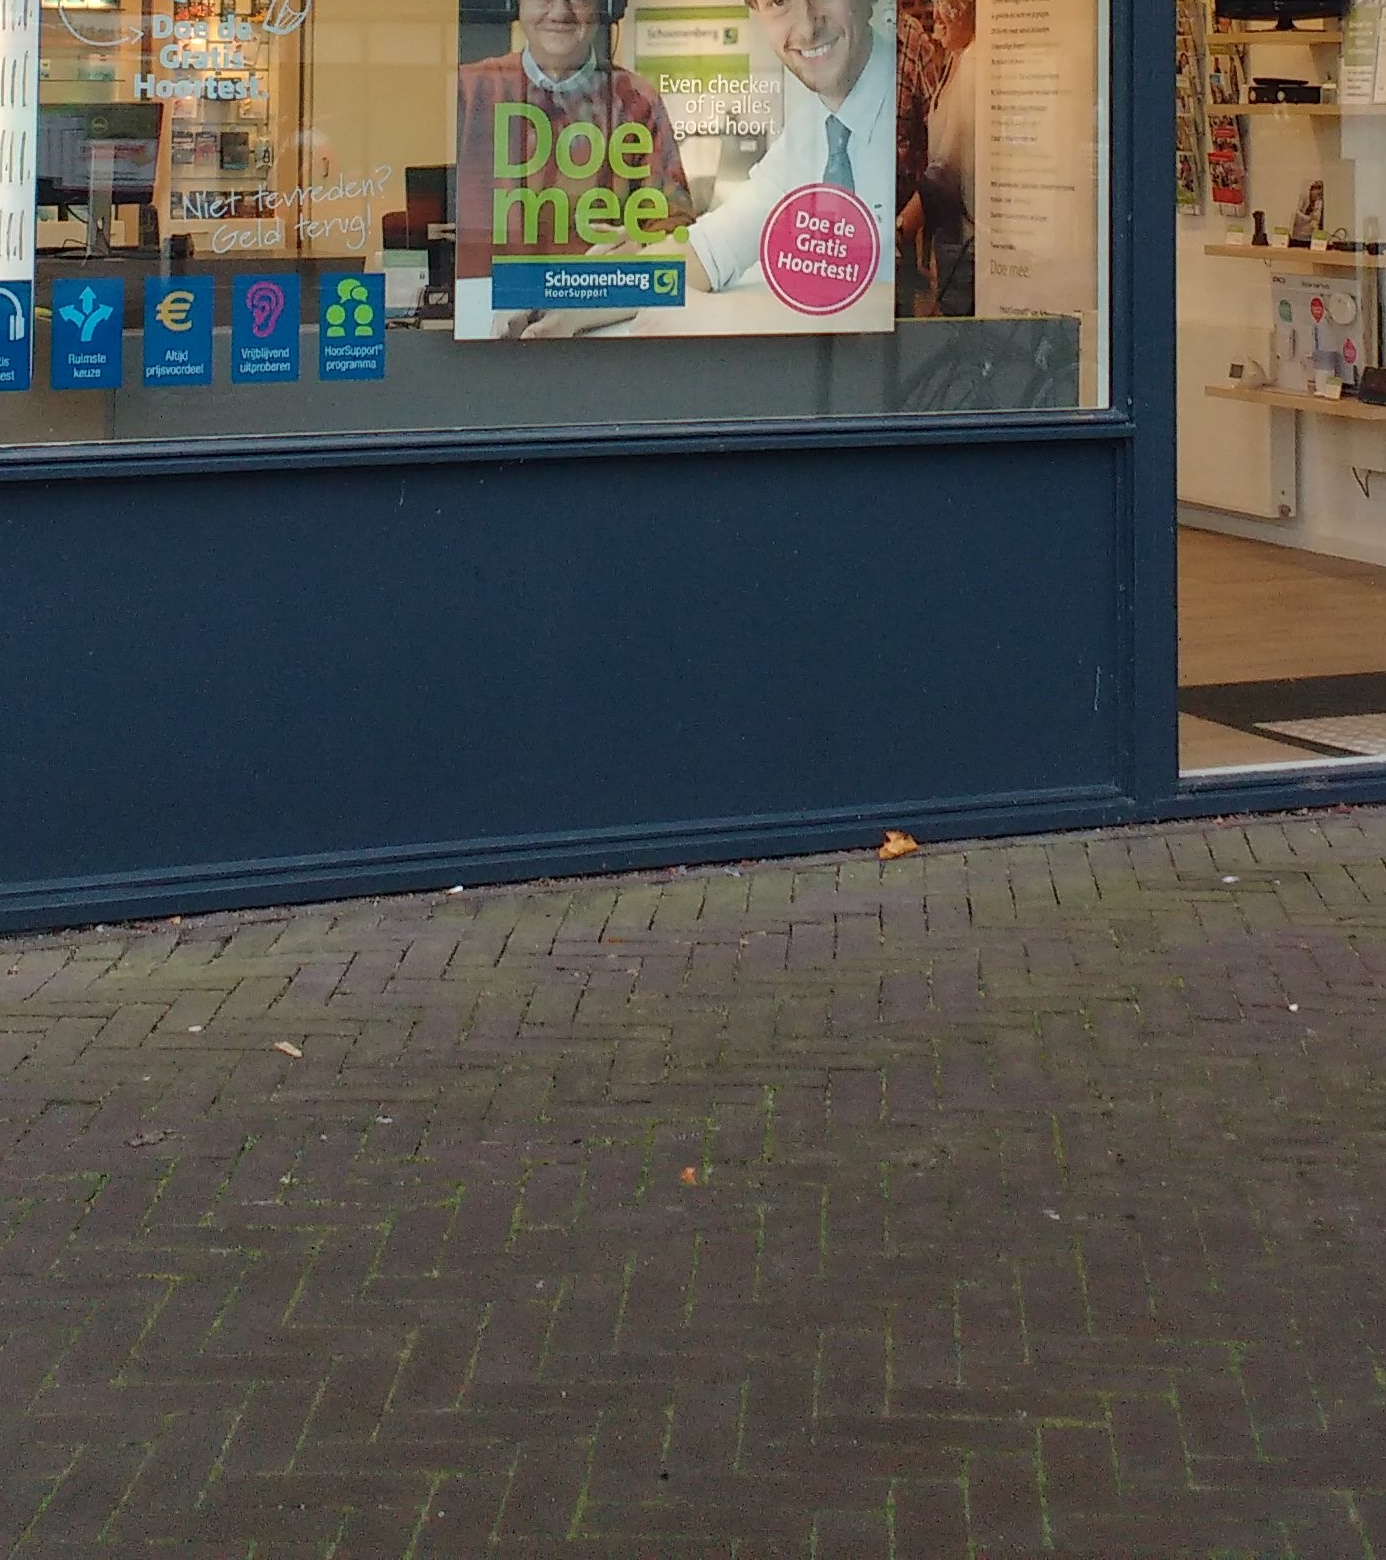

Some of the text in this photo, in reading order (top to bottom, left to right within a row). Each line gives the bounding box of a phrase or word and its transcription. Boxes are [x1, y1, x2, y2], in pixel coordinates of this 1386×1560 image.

[153, 14, 252, 41] Doe de
[159, 43, 244, 69] Gratis
[660, 74, 781, 94] Even checken
[685, 95, 771, 119] of je alles
[673, 115, 781, 140] goed hoort.
[493, 102, 654, 179] Doe
[182, 166, 392, 222] Niet tevreden?
[492, 187, 690, 244] mee.
[795, 210, 856, 238] Doe de
[212, 203, 372, 254] Geld terug!
[796, 233, 848, 258] Gratis
[777, 251, 860, 282] Hoortest!
[989, 259, 1008, 277] Doe
[544, 269, 650, 290] Schoonenberg
[544, 288, 608, 299] HoorSupport
[68, 353, 107, 365] Ruimste
[164, 349, 189, 363] Altijd
[240, 347, 290, 360] Vrijblijvend
[73, 367, 101, 378] keuze
[145, 362, 205, 378] prijsvoordeel
[239, 361, 291, 374] uitproberen
[325, 359, 377, 372] programma
